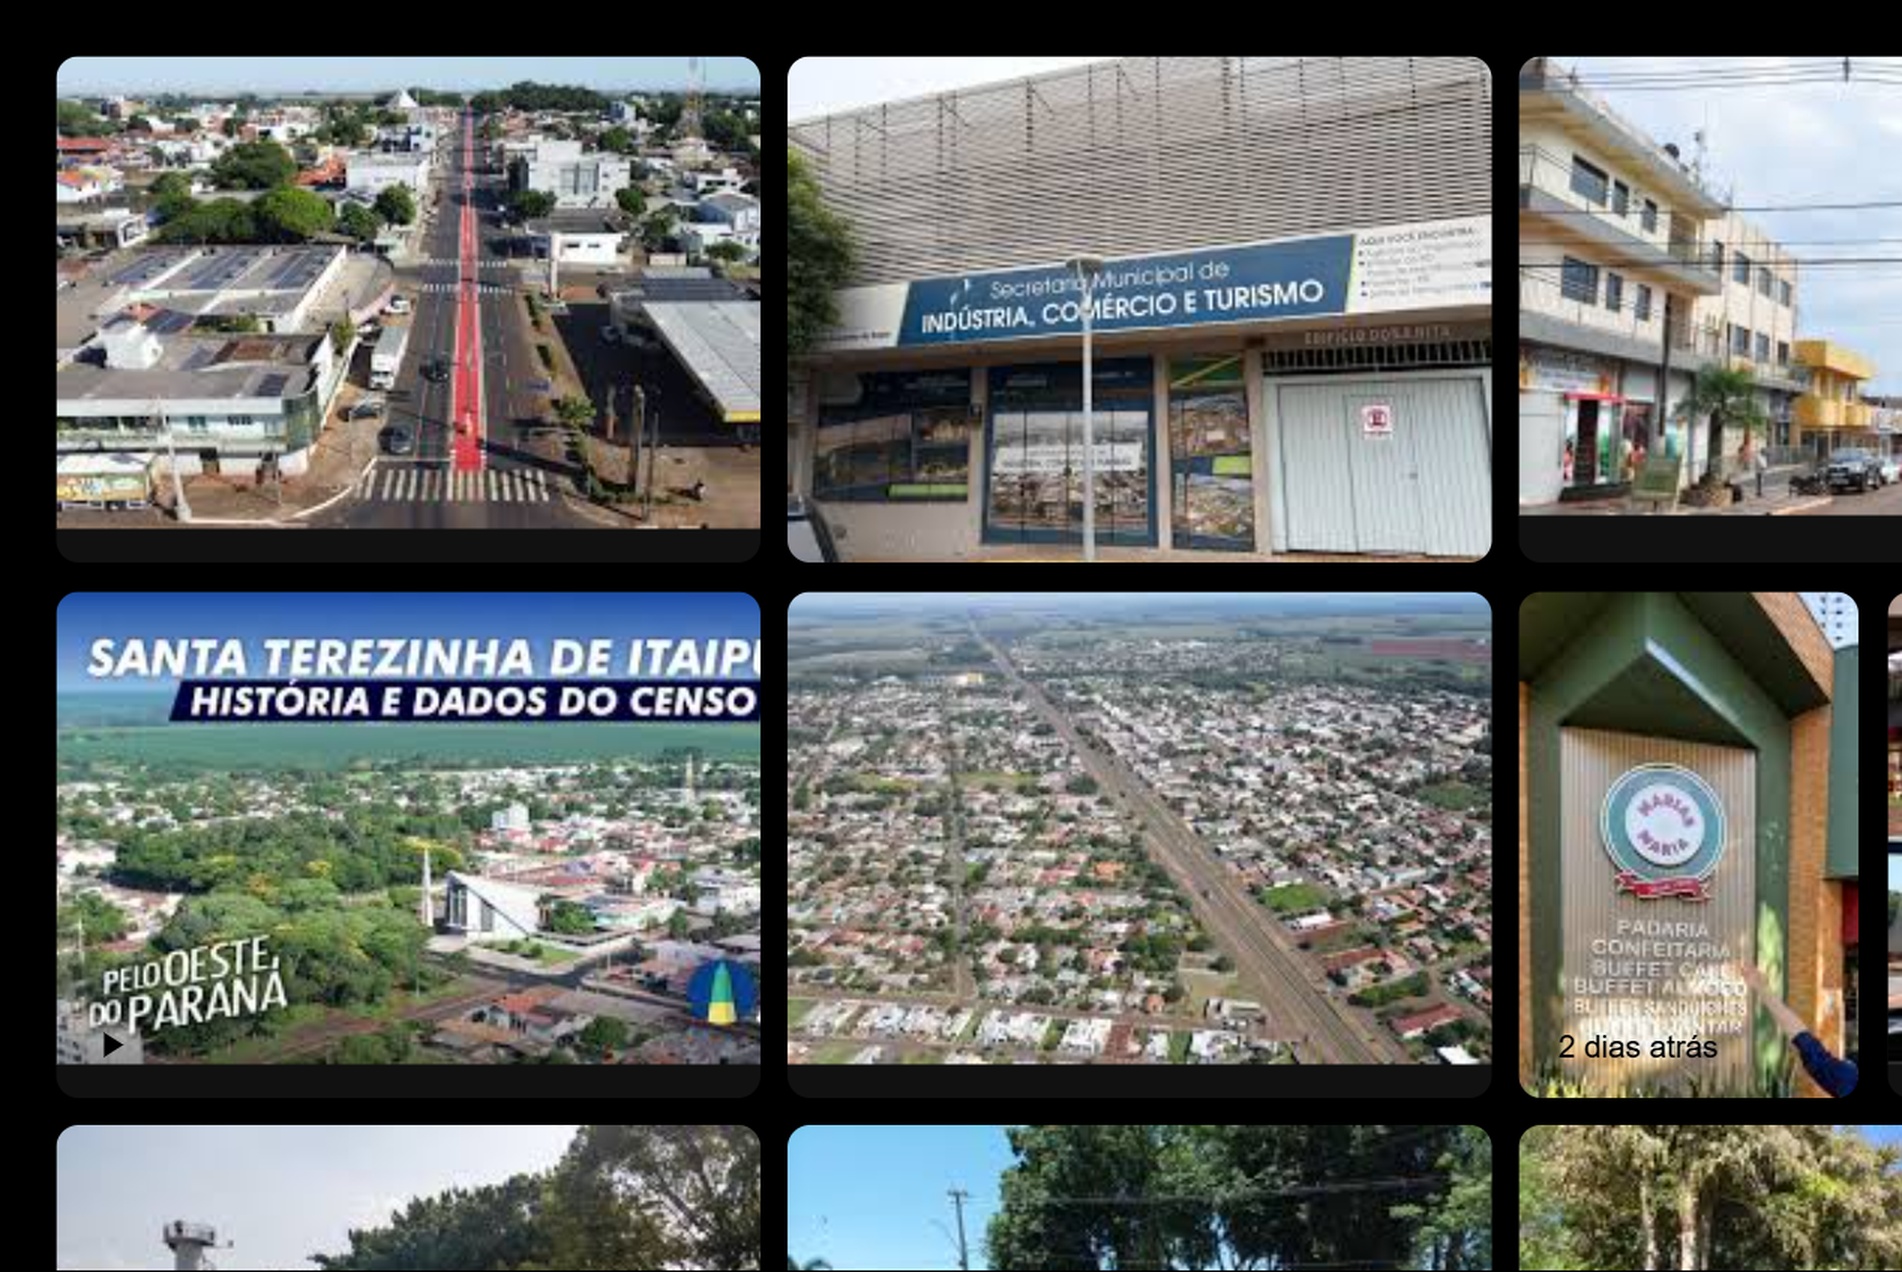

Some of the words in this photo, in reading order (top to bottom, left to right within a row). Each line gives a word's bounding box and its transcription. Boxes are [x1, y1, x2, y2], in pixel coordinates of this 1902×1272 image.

[1091, 262, 1194, 289] Municipal
[1199, 260, 1230, 280] de
[922, 304, 1036, 334] INDÚSTRIA,
[1184, 290, 1197, 314] E
[1203, 278, 1324, 312] TURISMO
[1637, 829, 1689, 856] MARIA
[1617, 920, 1709, 938] PADARIA
[1592, 939, 1731, 959] CONFEITARIA
[1592, 960, 1674, 977] BUFFET
[1574, 978, 1653, 995] BUFFET
